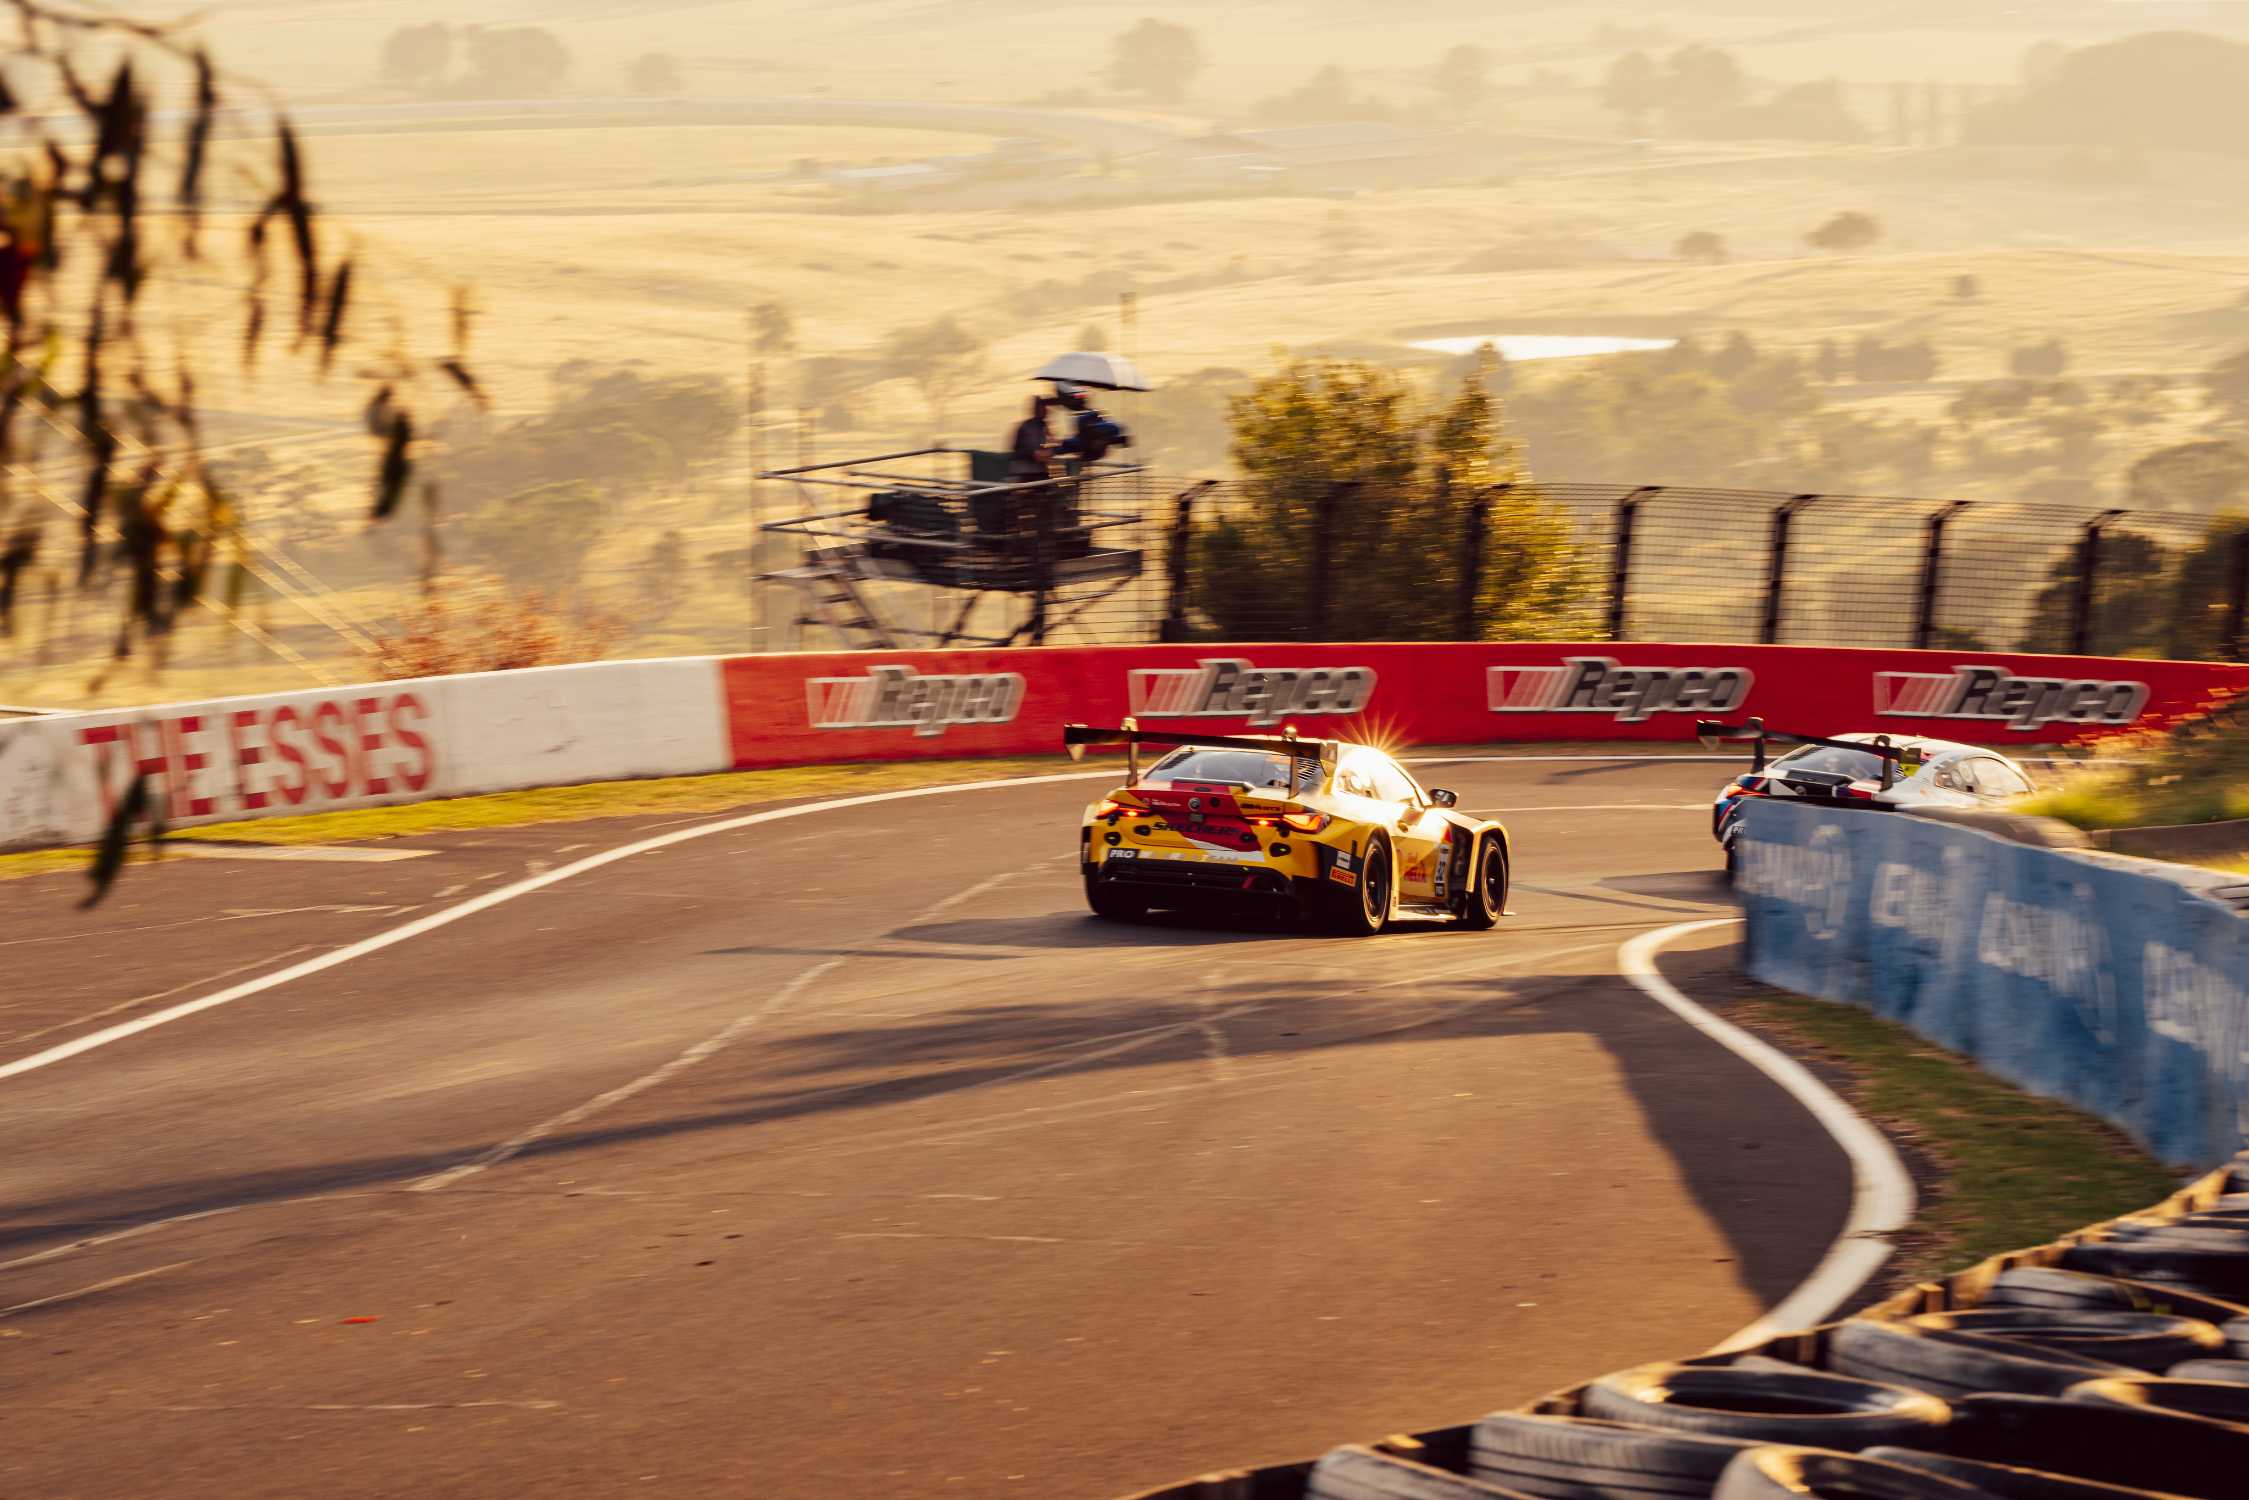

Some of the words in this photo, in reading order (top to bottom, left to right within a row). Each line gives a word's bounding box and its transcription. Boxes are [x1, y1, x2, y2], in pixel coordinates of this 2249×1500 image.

[867, 666, 1025, 736] Repco
[1198, 659, 1376, 725] Repco
[1563, 657, 1754, 720] Repco
[1953, 666, 2148, 729] Repco
[75, 714, 215, 822] THE
[231, 692, 435, 809] ESSES
[1109, 849, 1136, 859] PRO
[1331, 868, 1355, 886] PIRELLI
